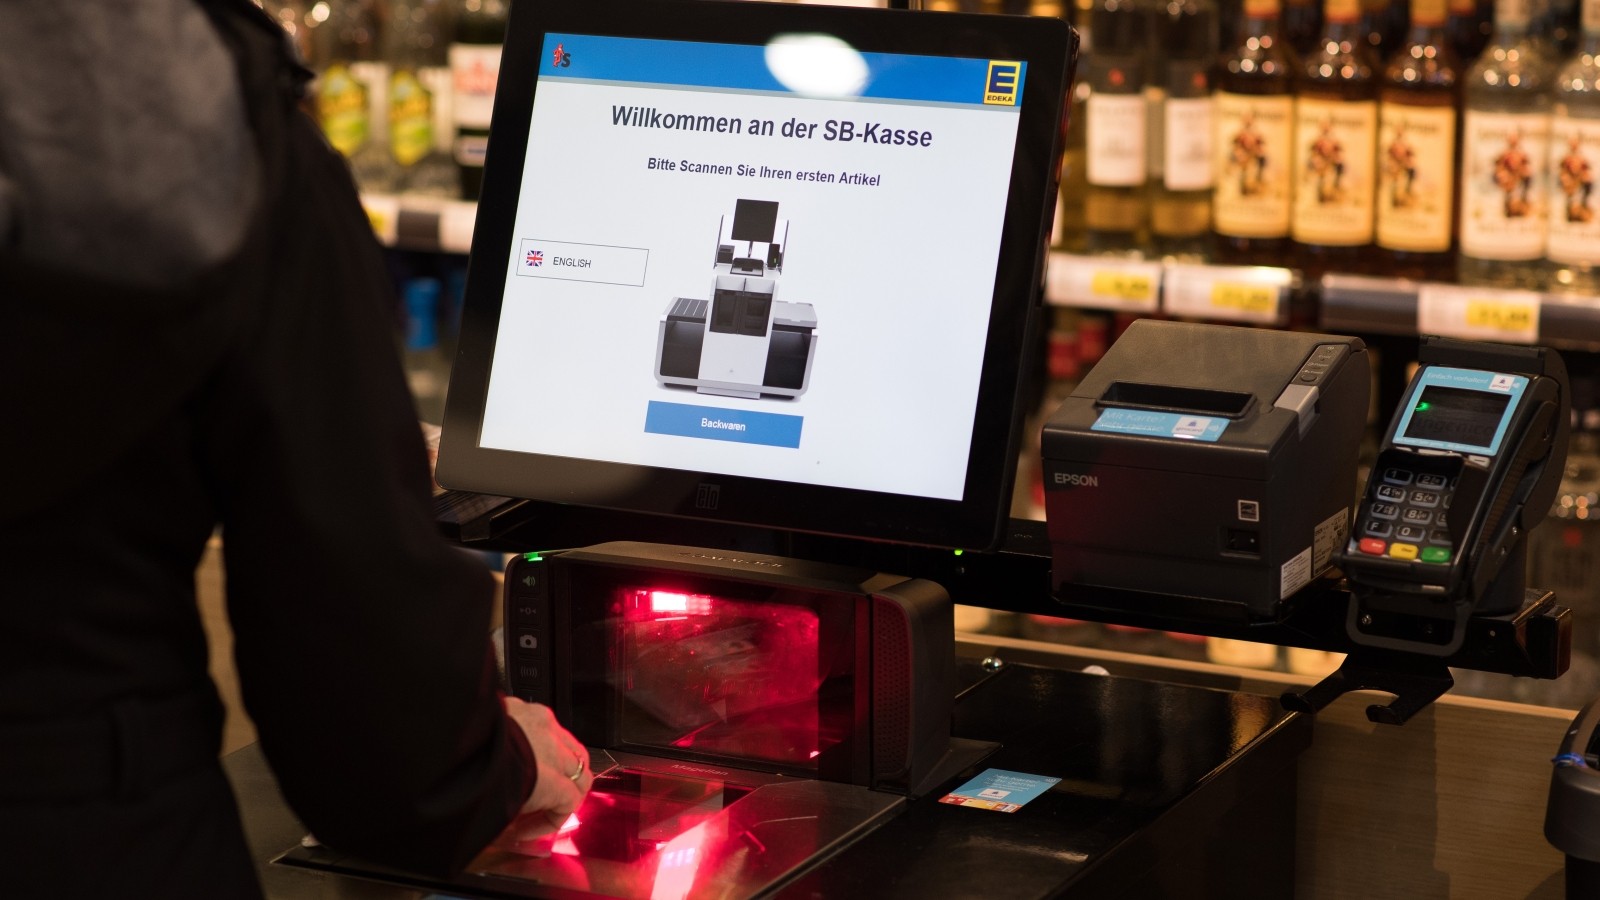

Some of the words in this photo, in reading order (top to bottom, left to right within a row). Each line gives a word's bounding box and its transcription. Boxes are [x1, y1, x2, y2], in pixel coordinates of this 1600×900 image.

[986, 94, 1013, 103] EDEKA
[612, 105, 742, 134] Willkommen
[748, 119, 774, 136] an
[781, 118, 817, 139] der
[823, 119, 933, 147] SB-Kasse
[647, 157, 676, 171] Bitte
[680, 160, 733, 176] Scannen
[737, 164, 756, 176] Sie
[759, 166, 792, 180] Ihren
[796, 170, 835, 183] ersten
[839, 172, 881, 187] Artikel
[553, 256, 592, 268] ENGLISH
[701, 417, 746, 431] Backwaren
[1054, 472, 1098, 487] EPSON
